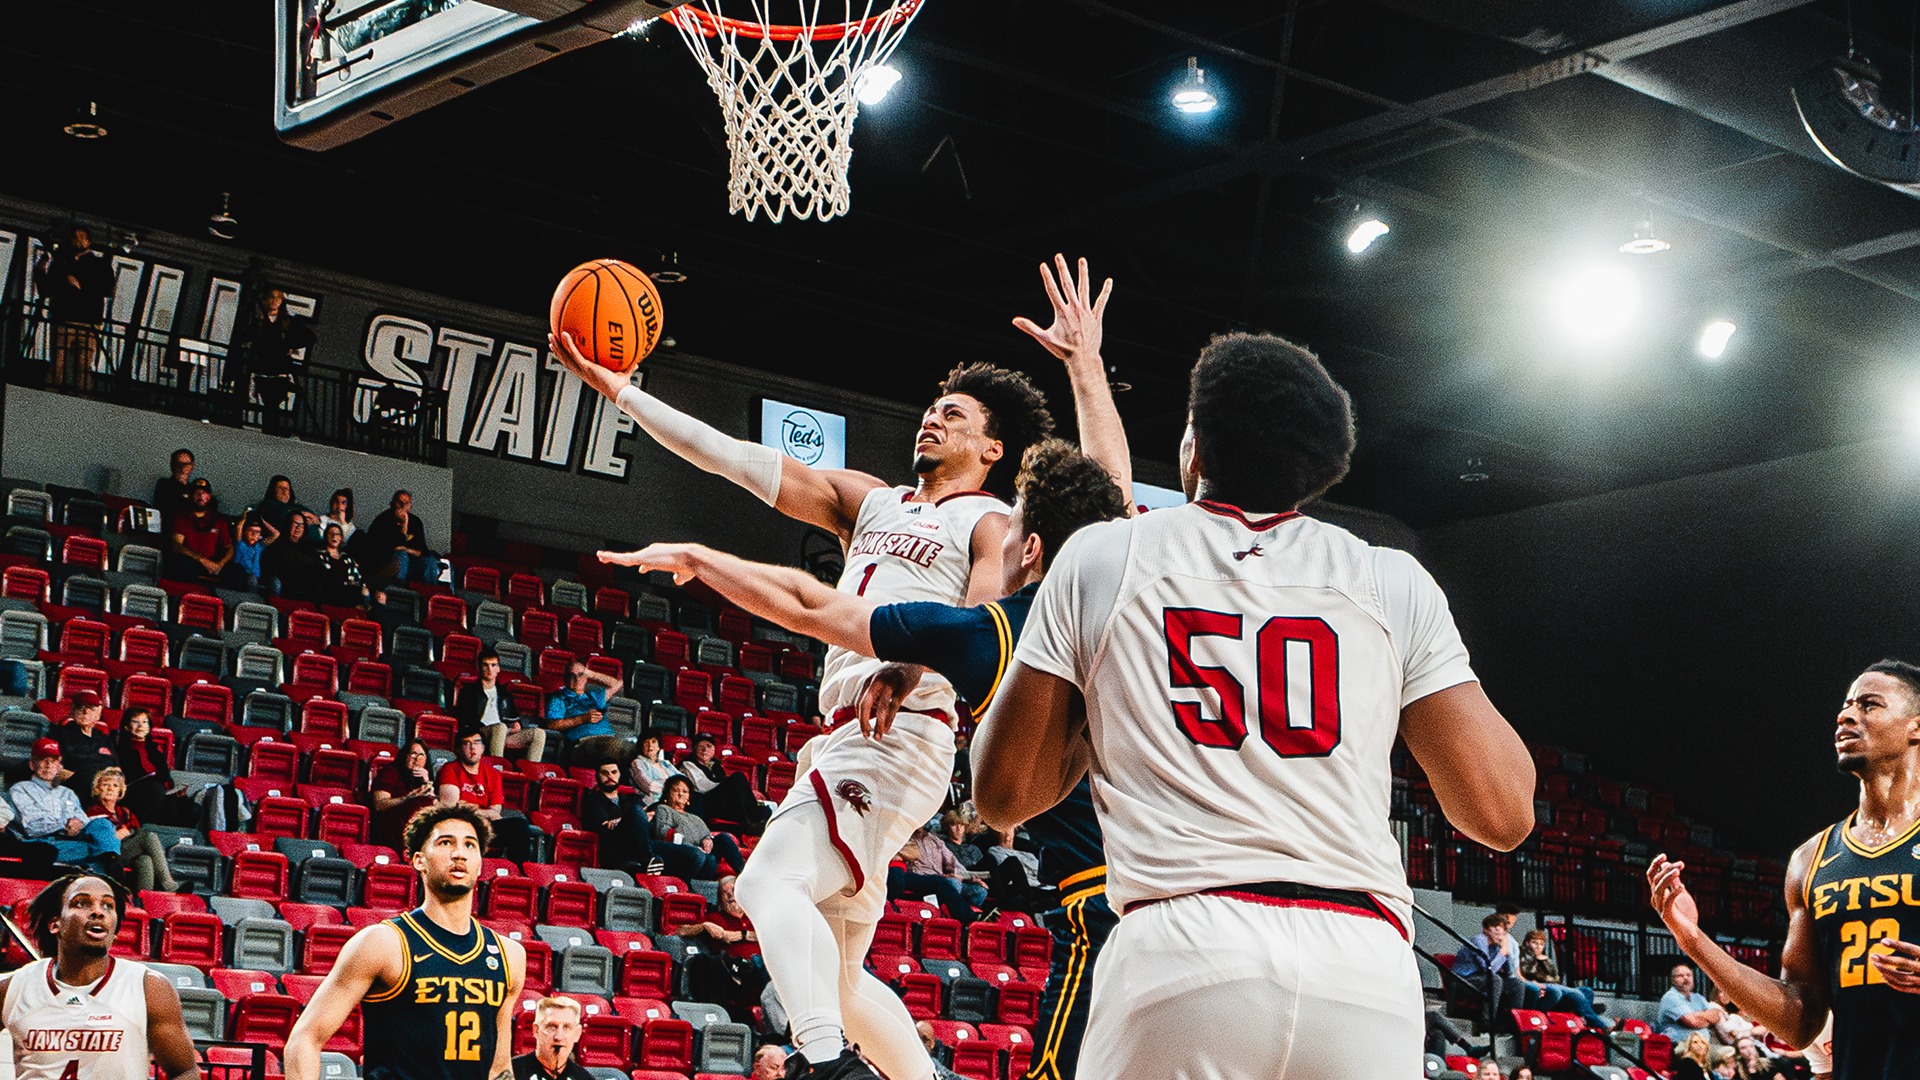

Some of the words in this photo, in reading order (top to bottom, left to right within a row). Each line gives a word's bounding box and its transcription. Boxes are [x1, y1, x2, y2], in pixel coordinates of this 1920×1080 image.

[353, 314, 643, 477] STATE
[783, 419, 824, 447] Ted's
[877, 533, 944, 568] STATE
[857, 563, 878, 597] 1
[1163, 607, 1342, 758] 50
[1840, 918, 1900, 988] 22
[415, 976, 505, 1007] ETSU
[22, 1029, 65, 1052] JAX
[64, 1029, 124, 1052] STATE
[444, 1010, 481, 1061] 12
